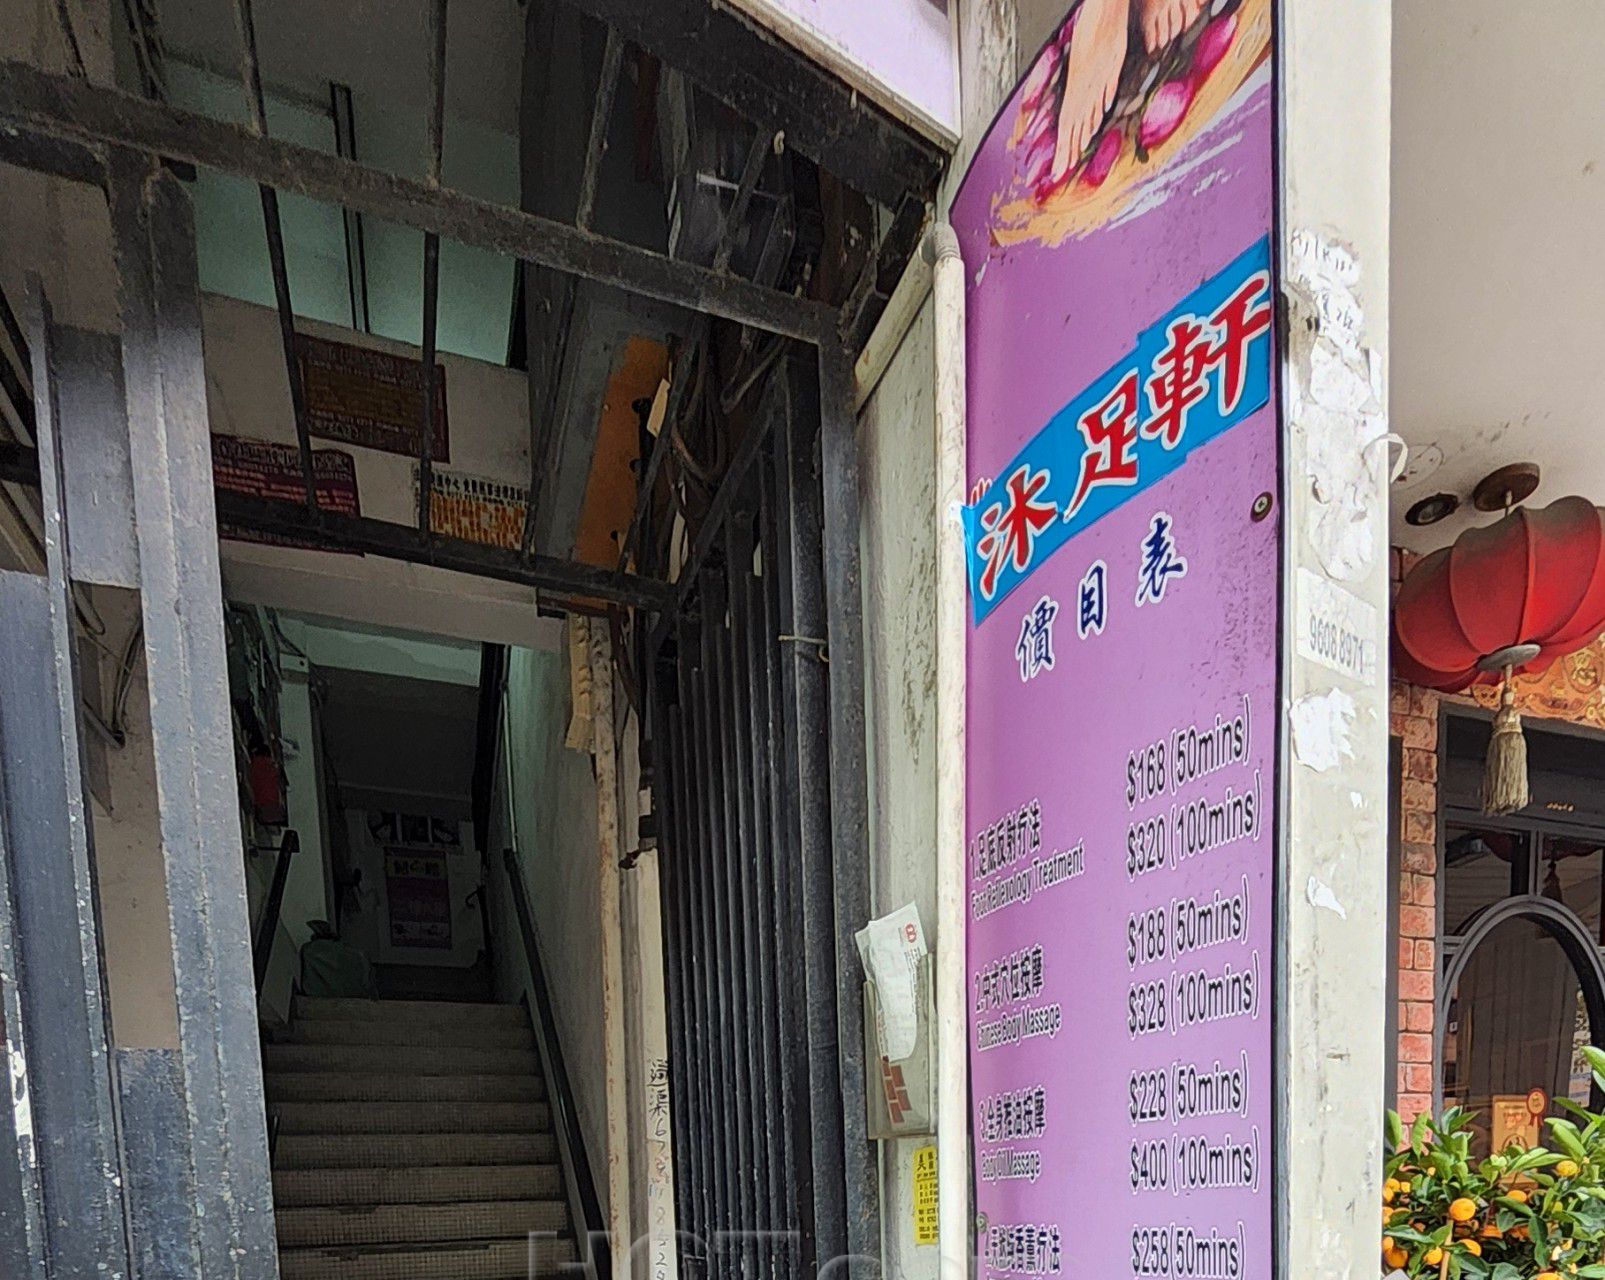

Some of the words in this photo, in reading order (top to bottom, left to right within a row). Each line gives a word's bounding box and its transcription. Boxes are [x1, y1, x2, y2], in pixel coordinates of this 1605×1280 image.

[1016, 512, 1187, 682] 價目表
[1309, 612, 1337, 661] 9608
[1127, 740, 1166, 811] $168
[1170, 693, 1250, 797] (50mins)
[1033, 837, 1085, 892] Treatment
[1127, 815, 1166, 881] $320
[1170, 768, 1262, 871] (100mins)
[1127, 906, 1166, 972] $188
[1170, 874, 1249, 963] (50mins)
[1022, 1003, 1061, 1039] Massage
[1128, 979, 1167, 1041] $328
[1170, 950, 1259, 1036] (100mins)
[1129, 1069, 1168, 1127] $228
[1170, 1049, 1249, 1126] (50mins)
[1130, 1137, 1169, 1195] $400
[1172, 1125, 1259, 1197] (100mins)
